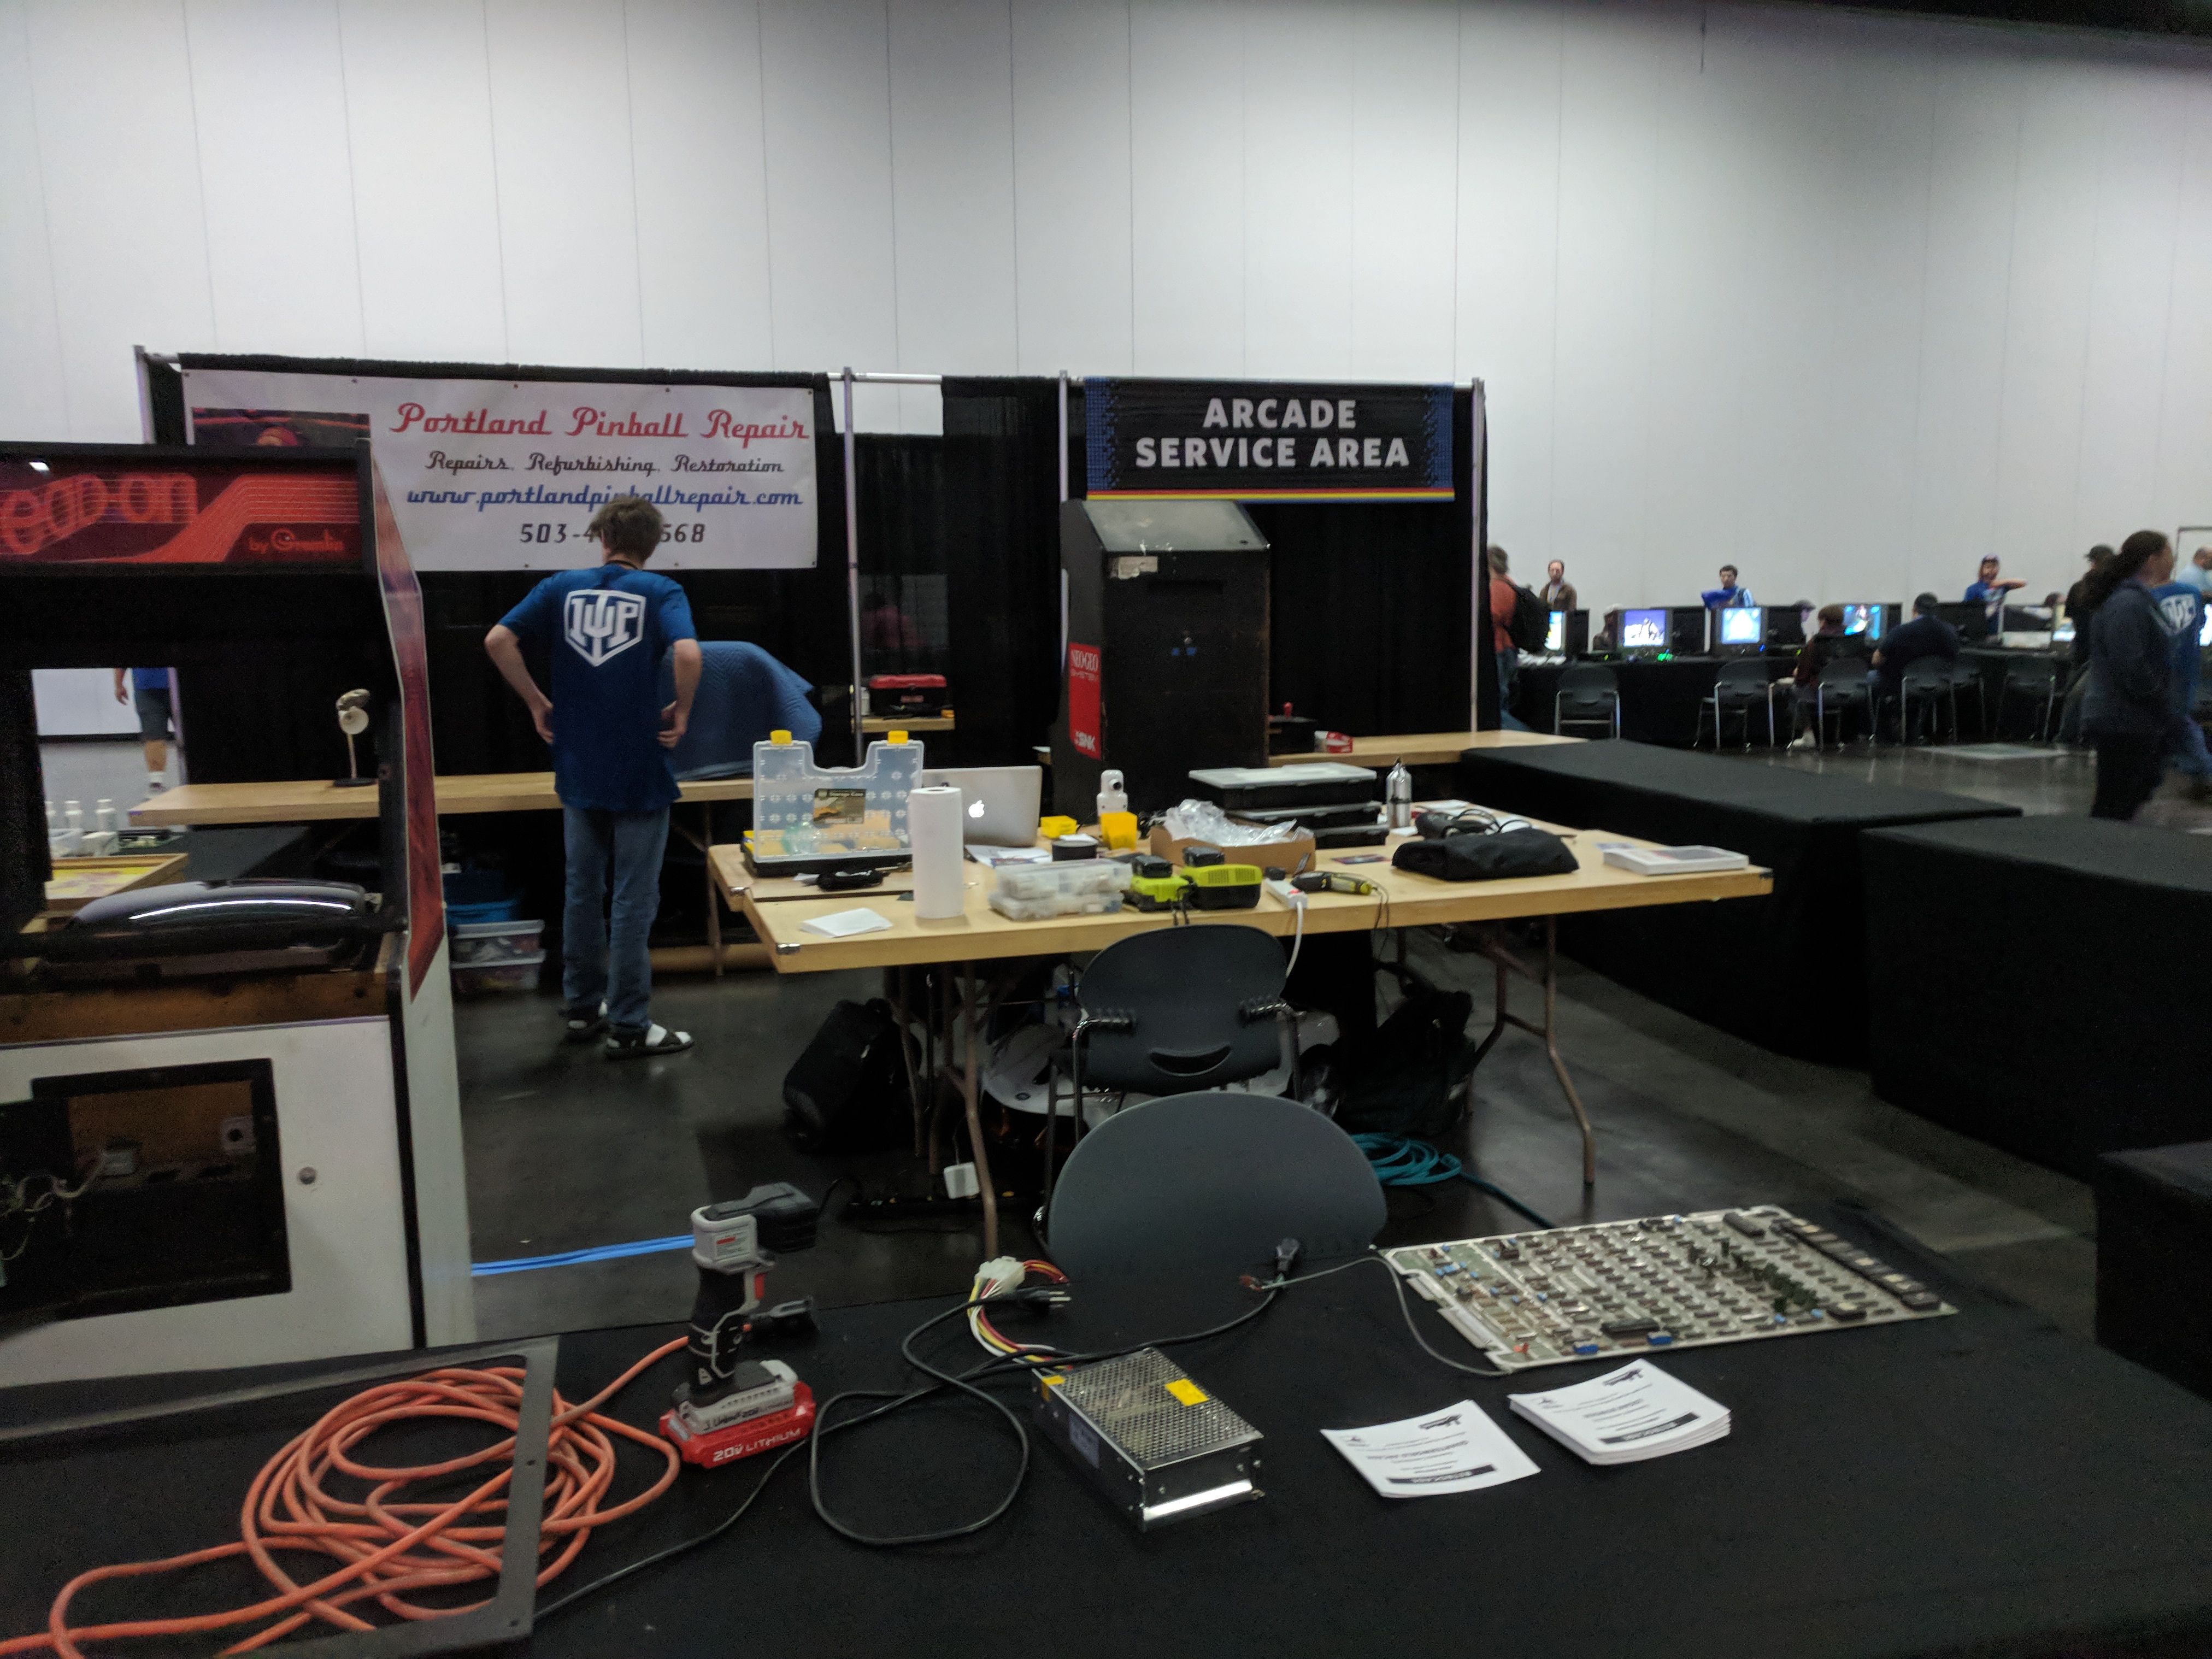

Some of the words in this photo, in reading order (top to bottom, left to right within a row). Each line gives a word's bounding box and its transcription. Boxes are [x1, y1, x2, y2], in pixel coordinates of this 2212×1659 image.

[390, 402, 552, 436] Portland
[565, 406, 689, 437] Pinball
[700, 409, 810, 449] Repair
[1202, 398, 1356, 428] ARCADE
[670, 454, 785, 473] Restoration
[1135, 437, 1296, 468] SERVICE
[1310, 437, 1410, 467] AREA
[520, 523, 705, 544] 503-4568
